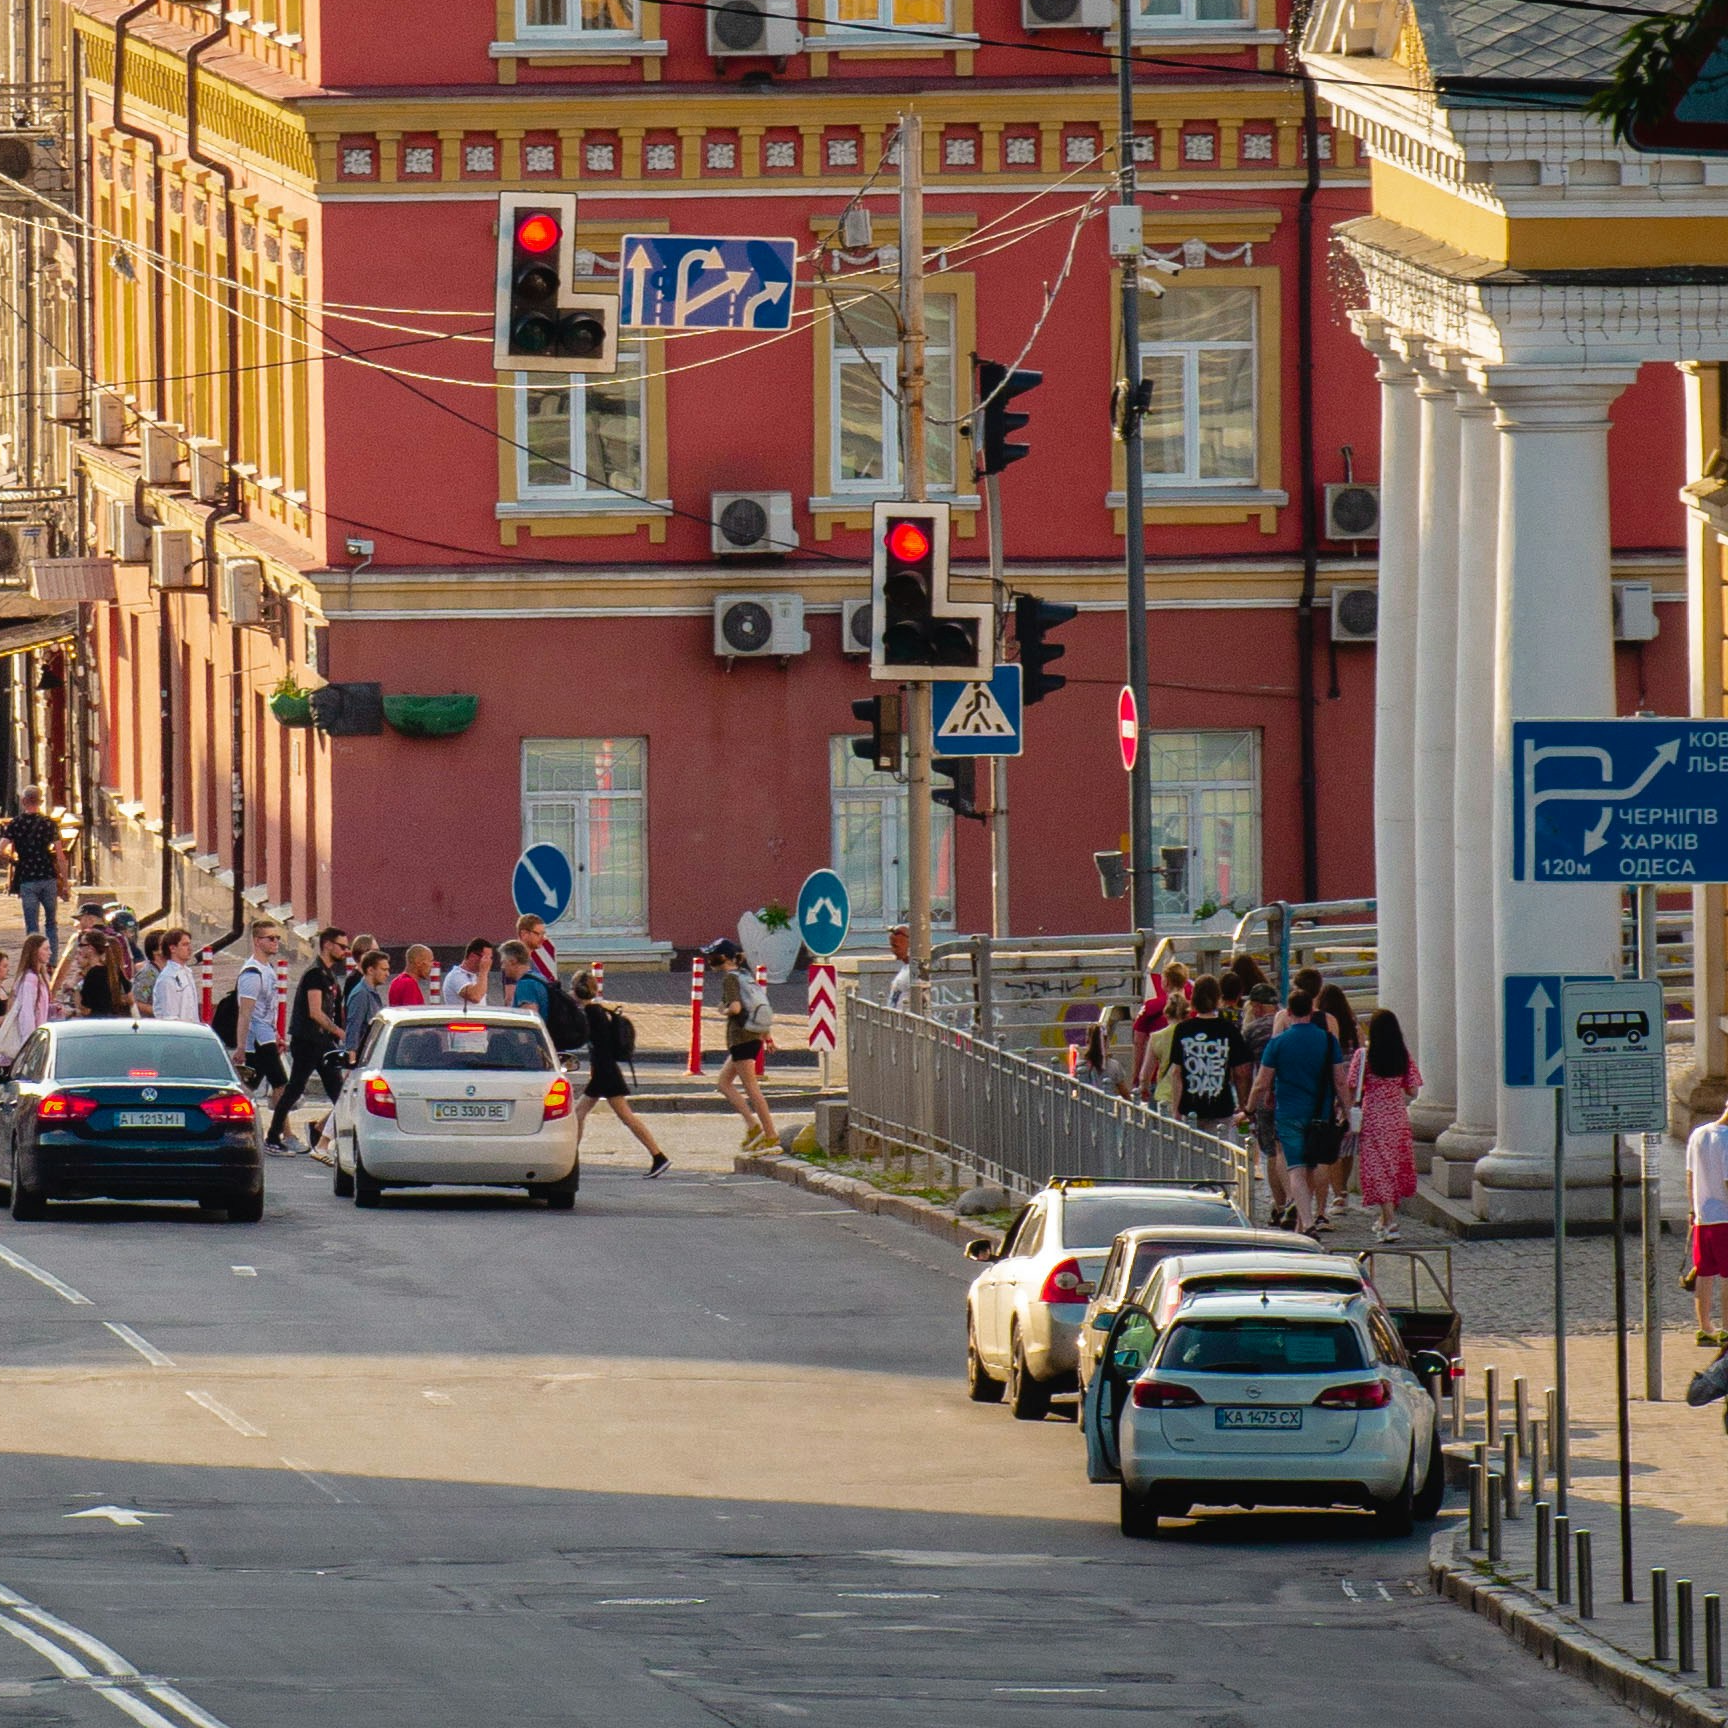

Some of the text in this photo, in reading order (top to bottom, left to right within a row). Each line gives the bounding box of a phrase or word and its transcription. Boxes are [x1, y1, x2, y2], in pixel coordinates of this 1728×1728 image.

[1619, 808, 1718, 825] ЧЕРНІГІВ
[1620, 834, 1698, 850] ХАРКІВ
[1541, 859, 1591, 875] 120м
[1619, 859, 1696, 878] ОДЕСА
[1180, 1033, 1230, 1058] RICH
[1184, 1057, 1226, 1076] ONE
[461, 1105, 486, 1117] 3300
[139, 1114, 162, 1125] 1213
[1224, 1409, 1300, 1424] KA 1475 CX
